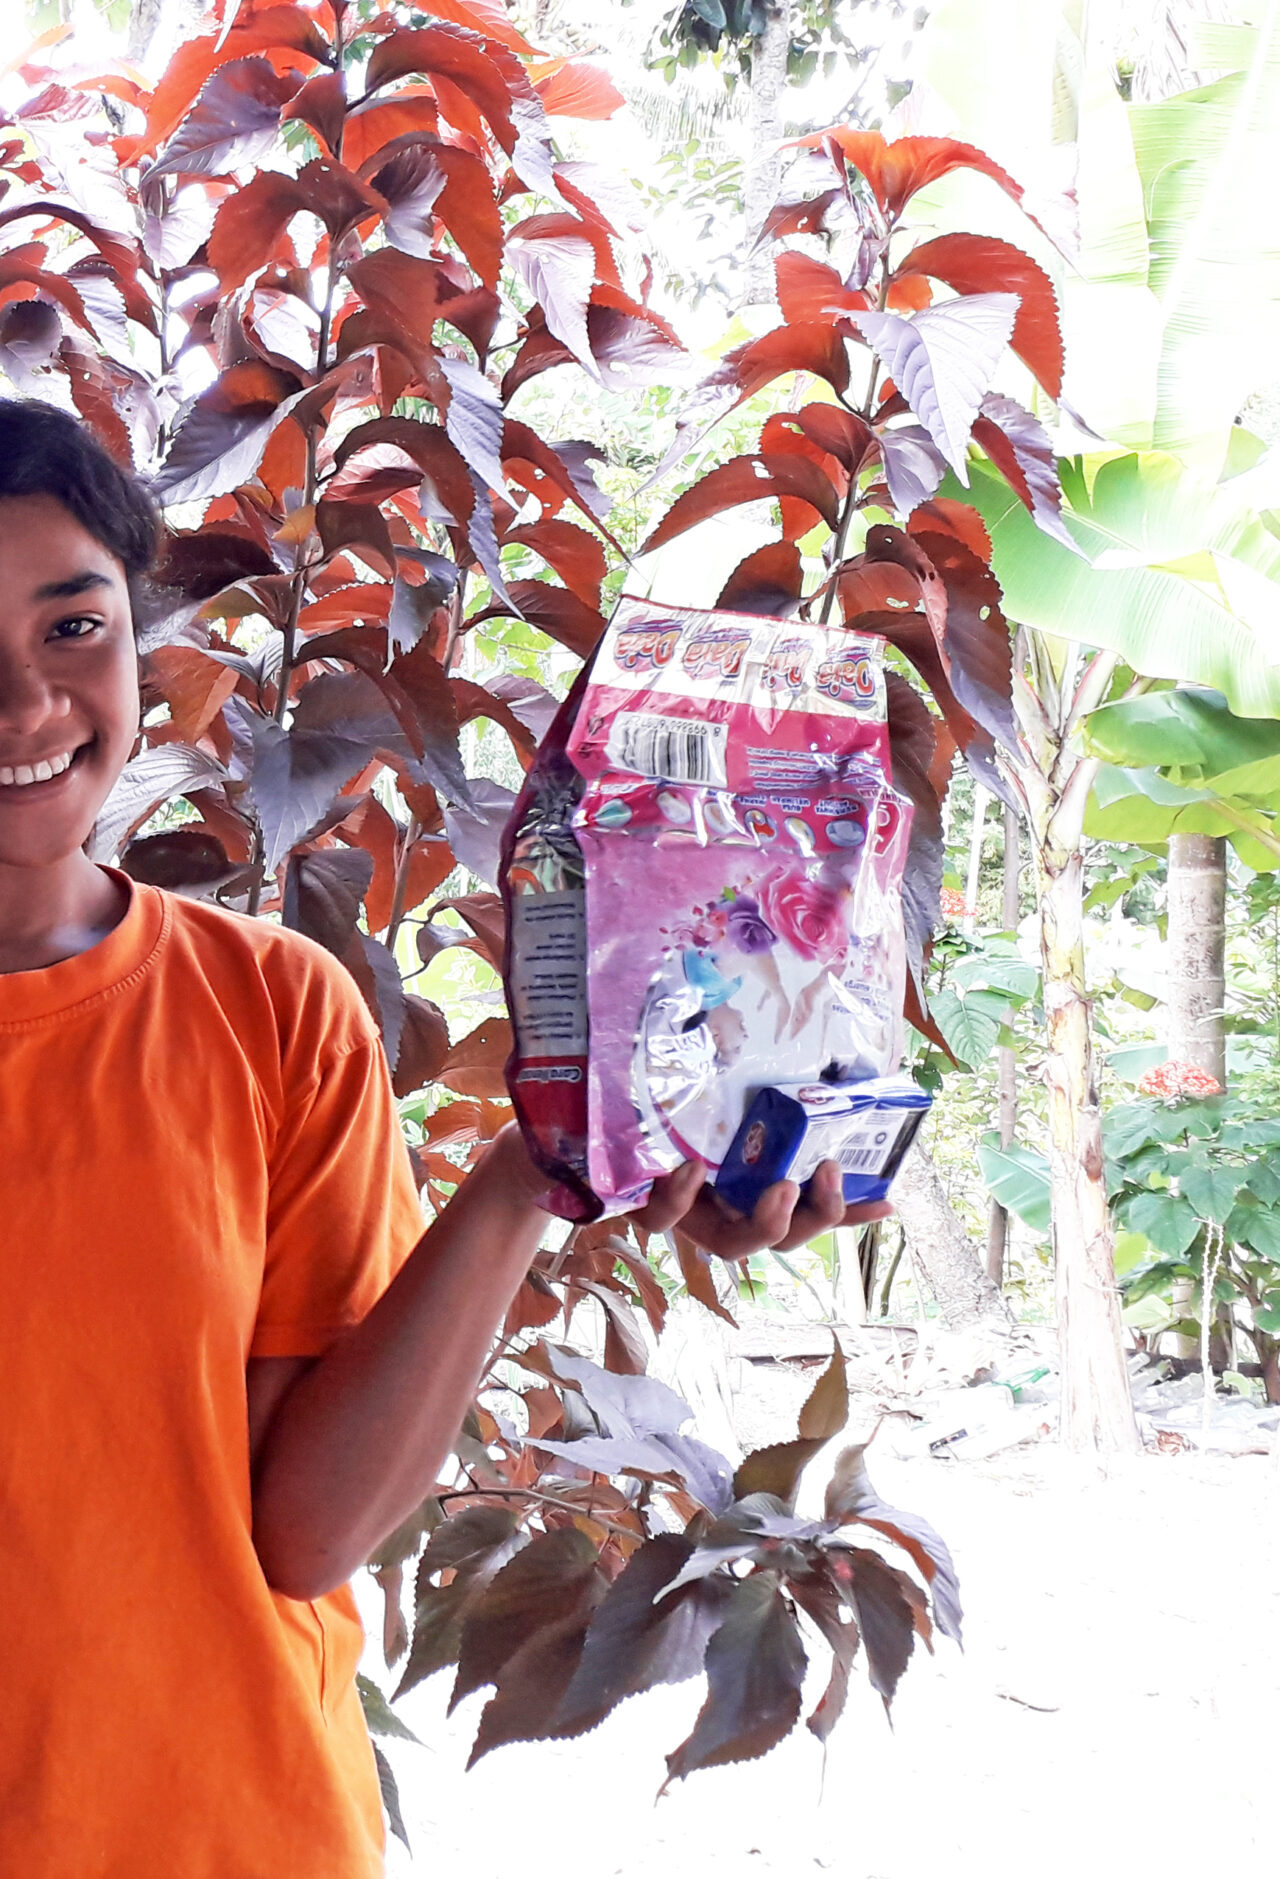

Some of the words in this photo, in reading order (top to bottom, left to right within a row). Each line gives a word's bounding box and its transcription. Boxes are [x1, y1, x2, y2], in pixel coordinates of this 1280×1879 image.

[616, 628, 683, 669] Daia
[681, 639, 751, 678] Daia
[817, 656, 876, 697] Daia
